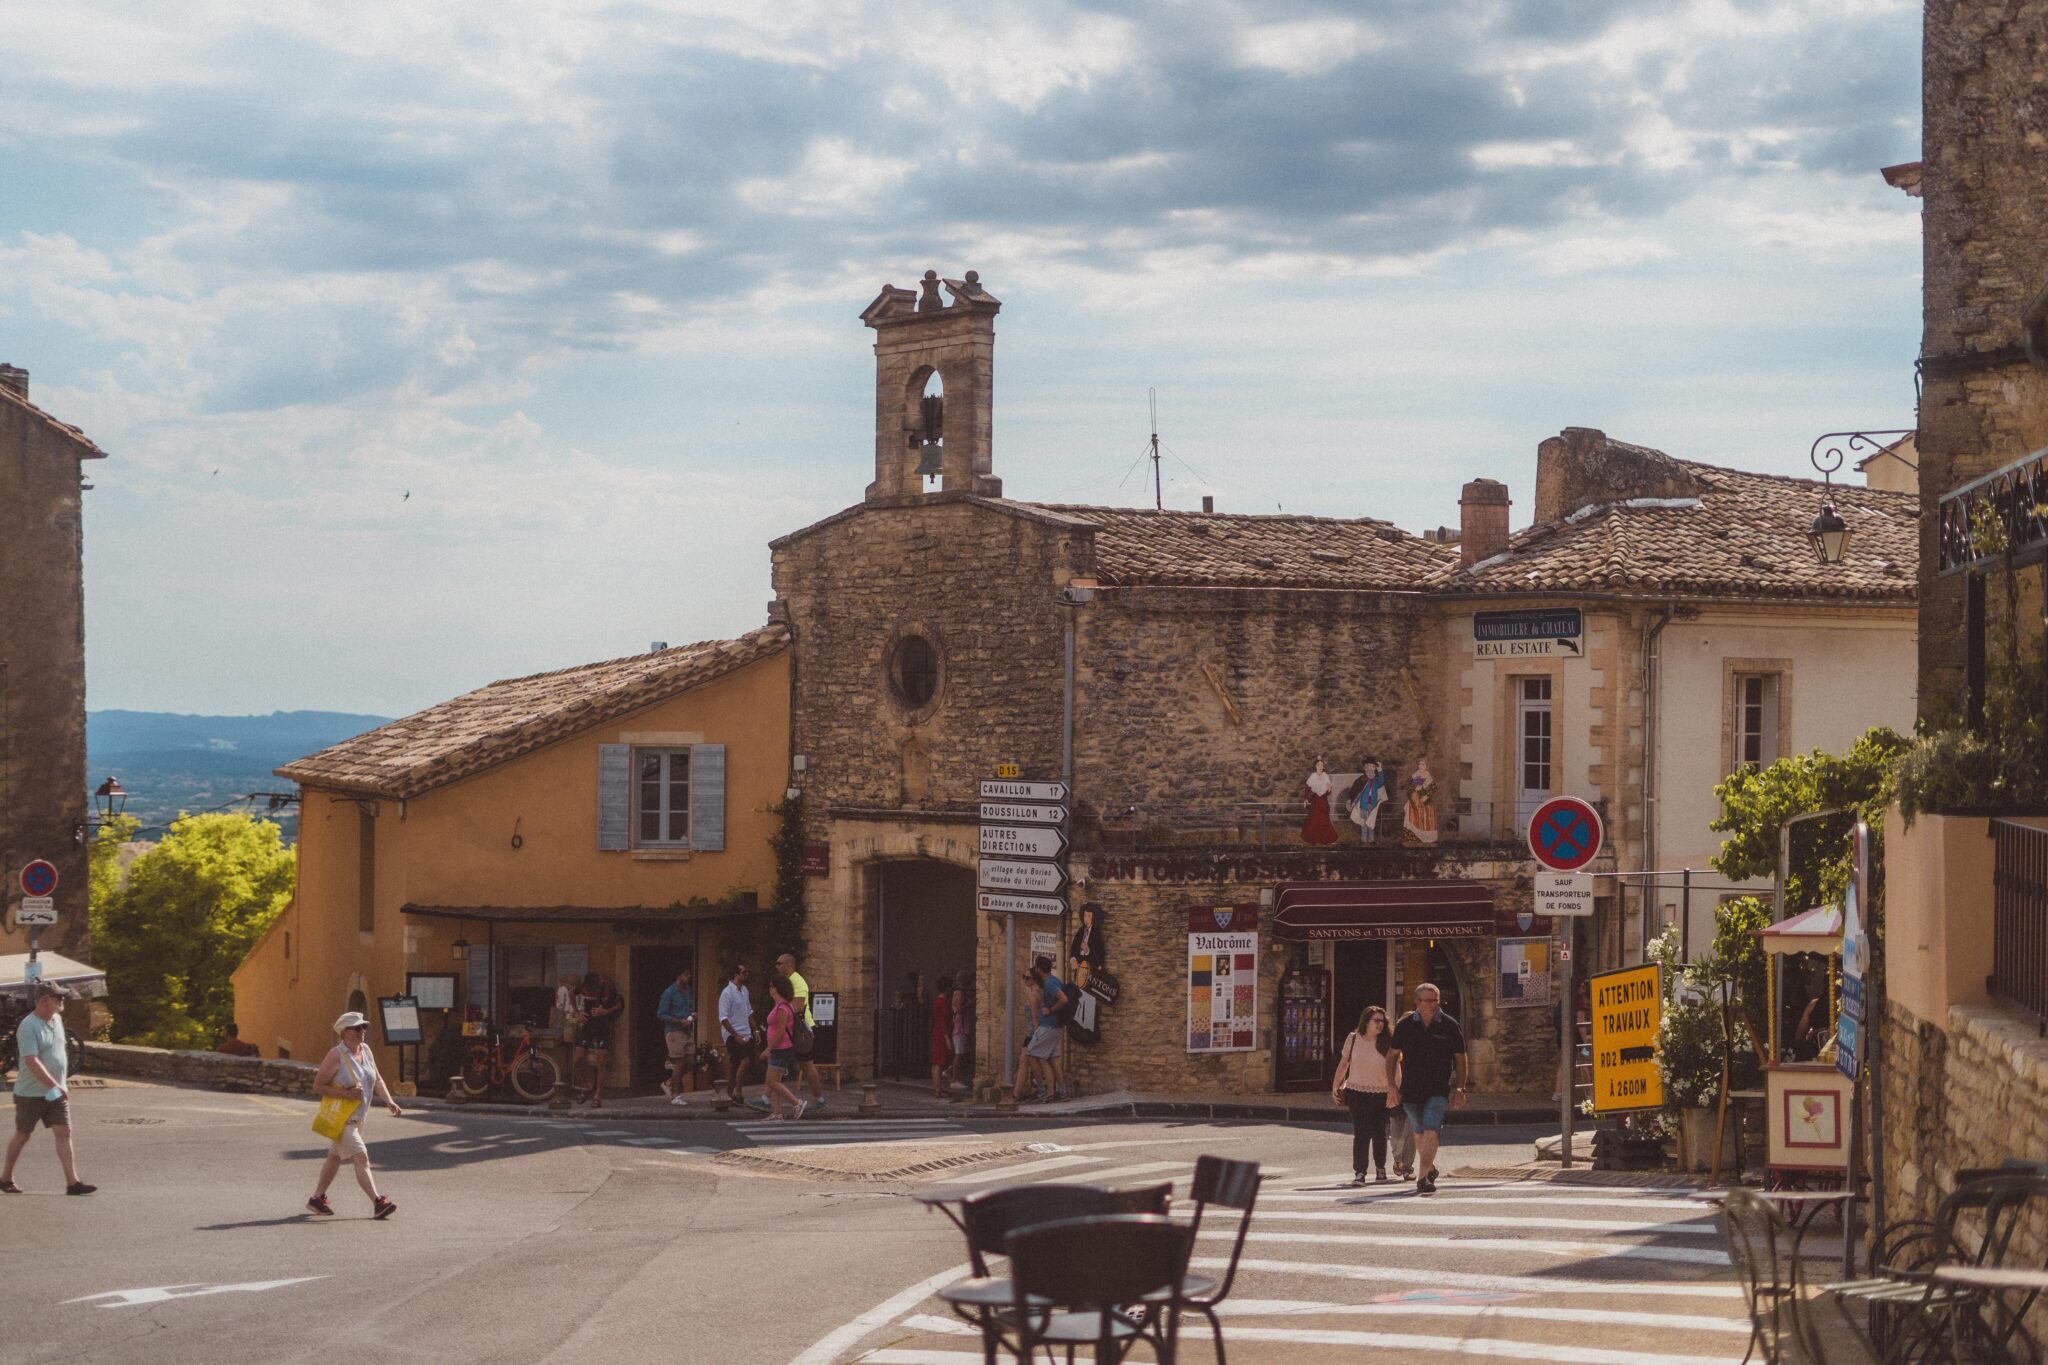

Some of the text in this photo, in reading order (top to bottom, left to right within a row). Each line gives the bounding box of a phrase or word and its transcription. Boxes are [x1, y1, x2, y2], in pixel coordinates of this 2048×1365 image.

[1477, 642, 1552, 655] REAL ESTATE
[1006, 766, 1017, 776] 15
[982, 784, 1059, 797] CAVAILLON 17
[982, 806, 1059, 819] ROUSSILLON 12
[982, 829, 1017, 840] AUTRES
[982, 840, 1038, 853] DIRECTIONS
[991, 866, 1052, 876] village des Bories
[1013, 877, 1022, 885] du
[1025, 878, 1047, 886] Vitrail
[1536, 890, 1591, 898] TRANSPORTEUR
[990, 898, 1013, 908] abbaye
[1033, 932, 1057, 944] Santon
[1308, 926, 1484, 938] SANTONS et TISSUS de PROVENCE
[1195, 934, 1252, 950] Valdrôme
[1087, 974, 1118, 994] ANTONS
[1599, 978, 1654, 1008] ATTENTION
[1603, 1008, 1650, 1035] TRAVAUX
[1609, 1078, 1647, 1097] À 2600M
